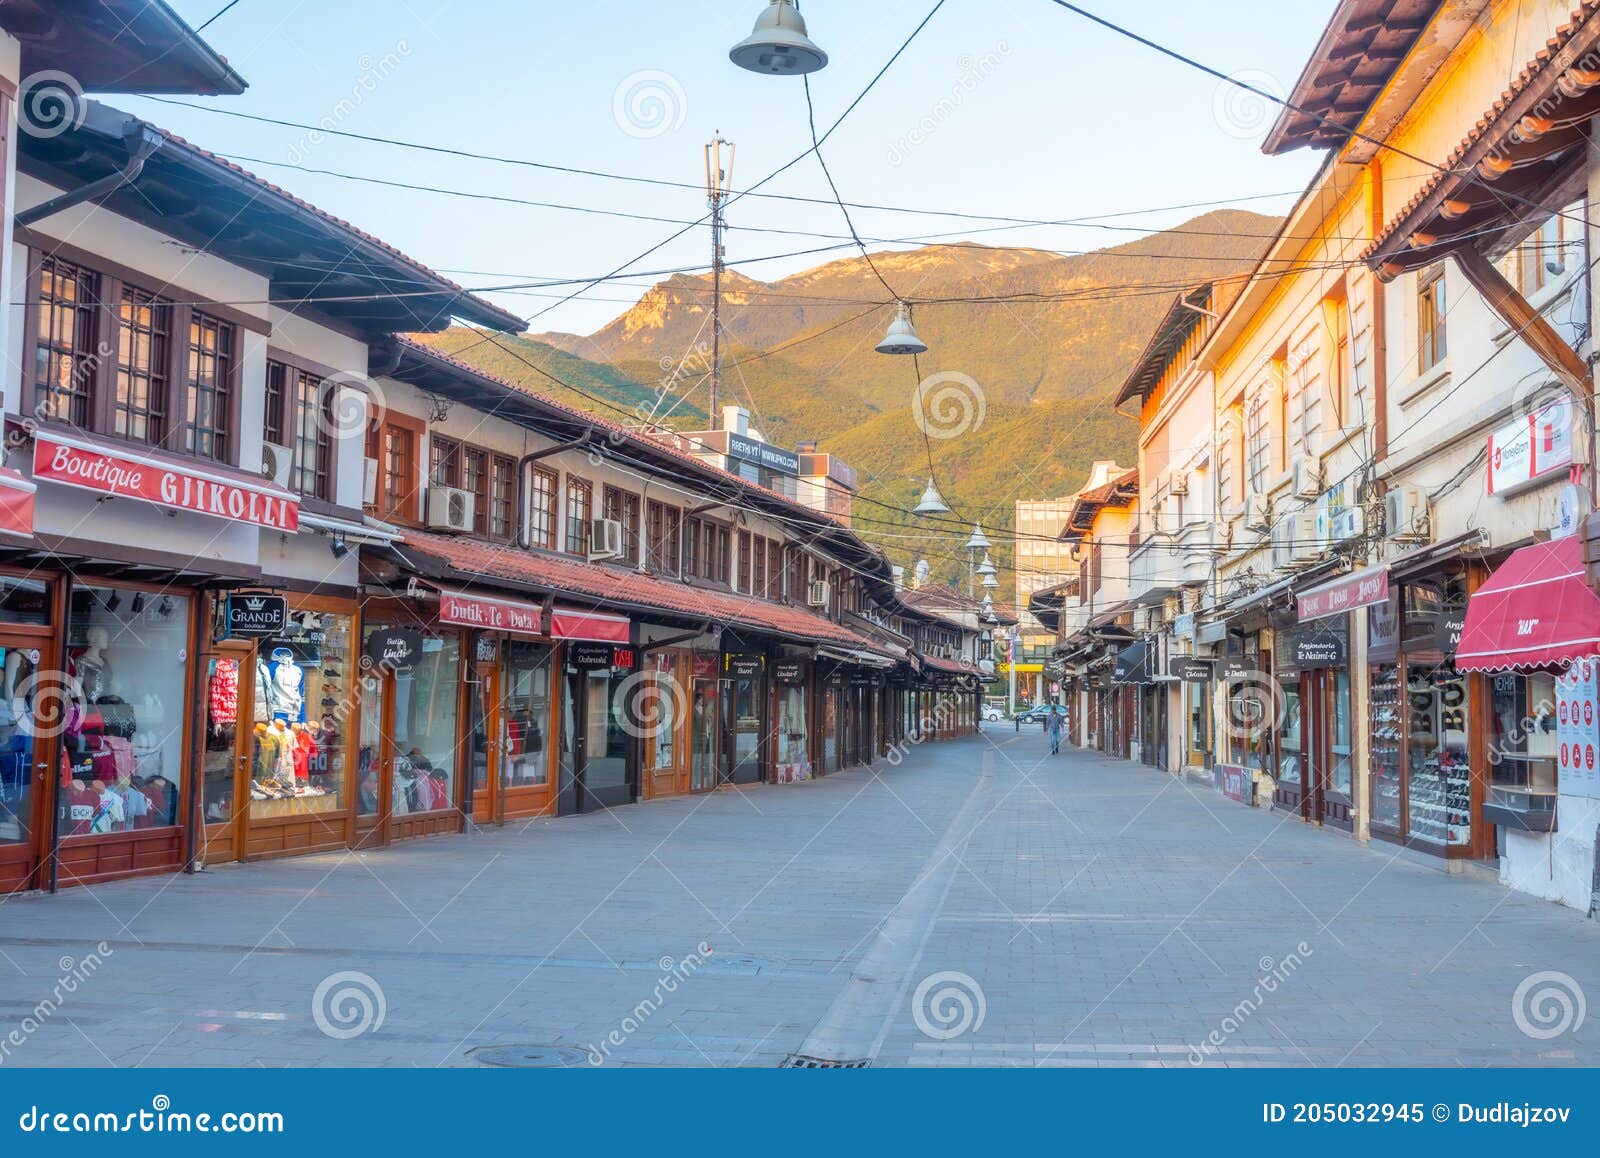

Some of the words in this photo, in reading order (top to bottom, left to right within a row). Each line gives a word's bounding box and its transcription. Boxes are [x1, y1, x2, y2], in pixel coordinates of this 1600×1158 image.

[51, 445, 142, 491] Boutique
[160, 472, 288, 528] GJIKOLLI
[230, 608, 281, 623] GRANDE
